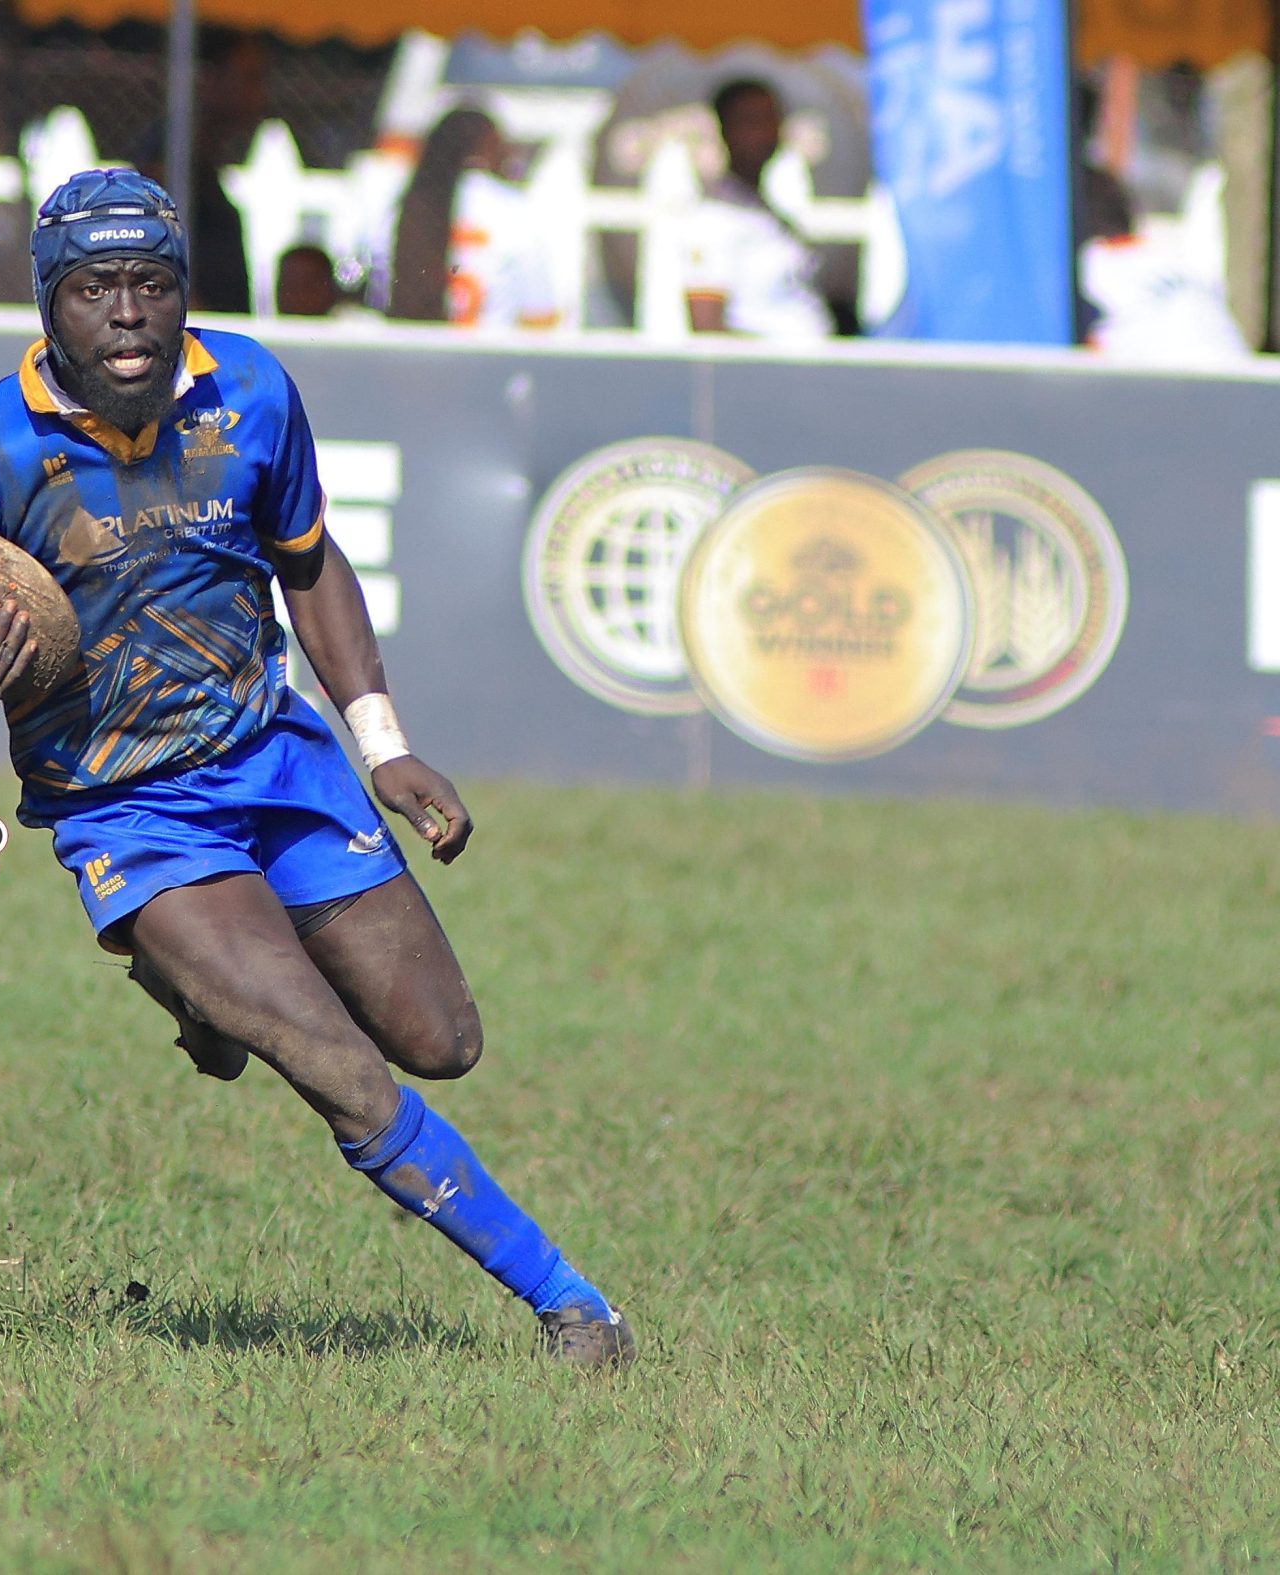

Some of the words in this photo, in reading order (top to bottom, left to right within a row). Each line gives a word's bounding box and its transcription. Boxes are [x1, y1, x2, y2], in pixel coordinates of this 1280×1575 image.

[89, 229, 145, 242] OFFLOAD
[90, 497, 234, 544] PLATINUM
[164, 524, 209, 540] CREDIT
[210, 522, 233, 537] LTD
[101, 558, 139, 575] There
